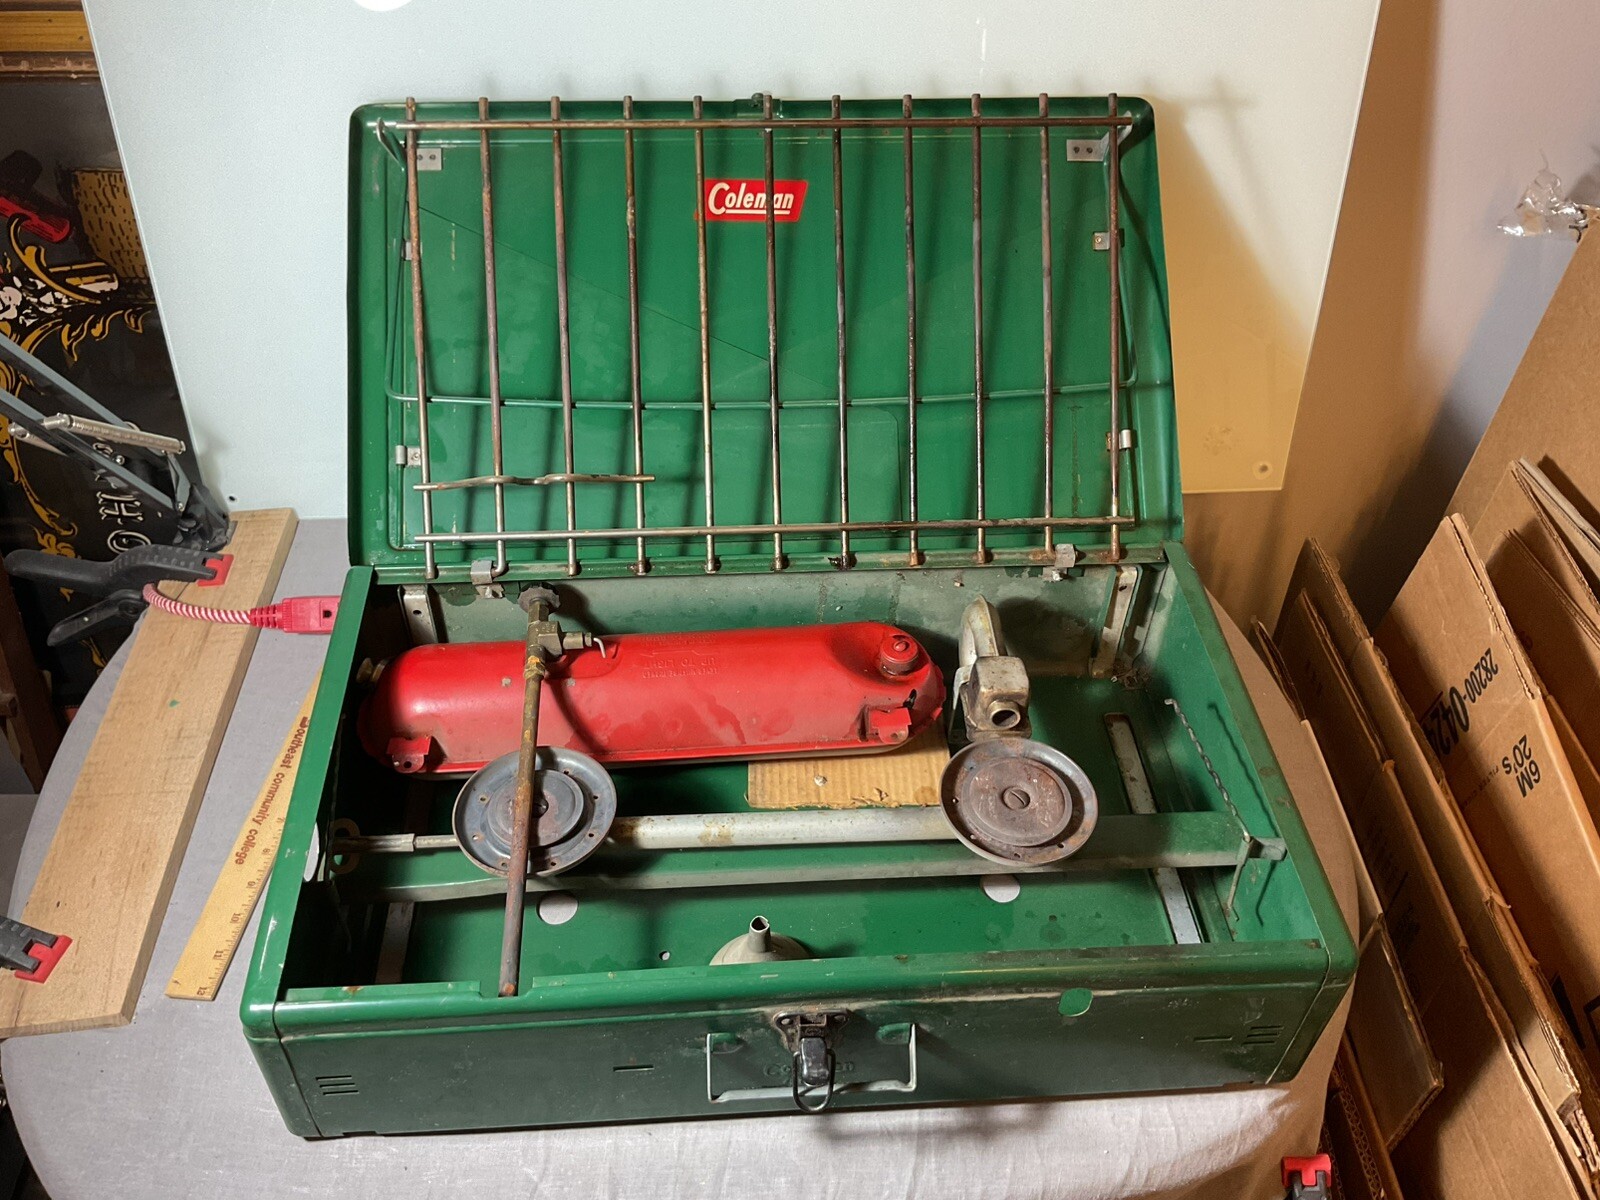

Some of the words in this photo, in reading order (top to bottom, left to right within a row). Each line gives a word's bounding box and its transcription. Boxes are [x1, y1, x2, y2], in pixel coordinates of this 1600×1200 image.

[708, 182, 794, 215] Coleman
[1502, 734, 1532, 775] 20's
[1516, 759, 1541, 798] 6M
[252, 772, 285, 826] community
[235, 828, 258, 865] college
[231, 912, 241, 923] 10
[213, 950, 224, 959] 11
[196, 986, 207, 995] 12
